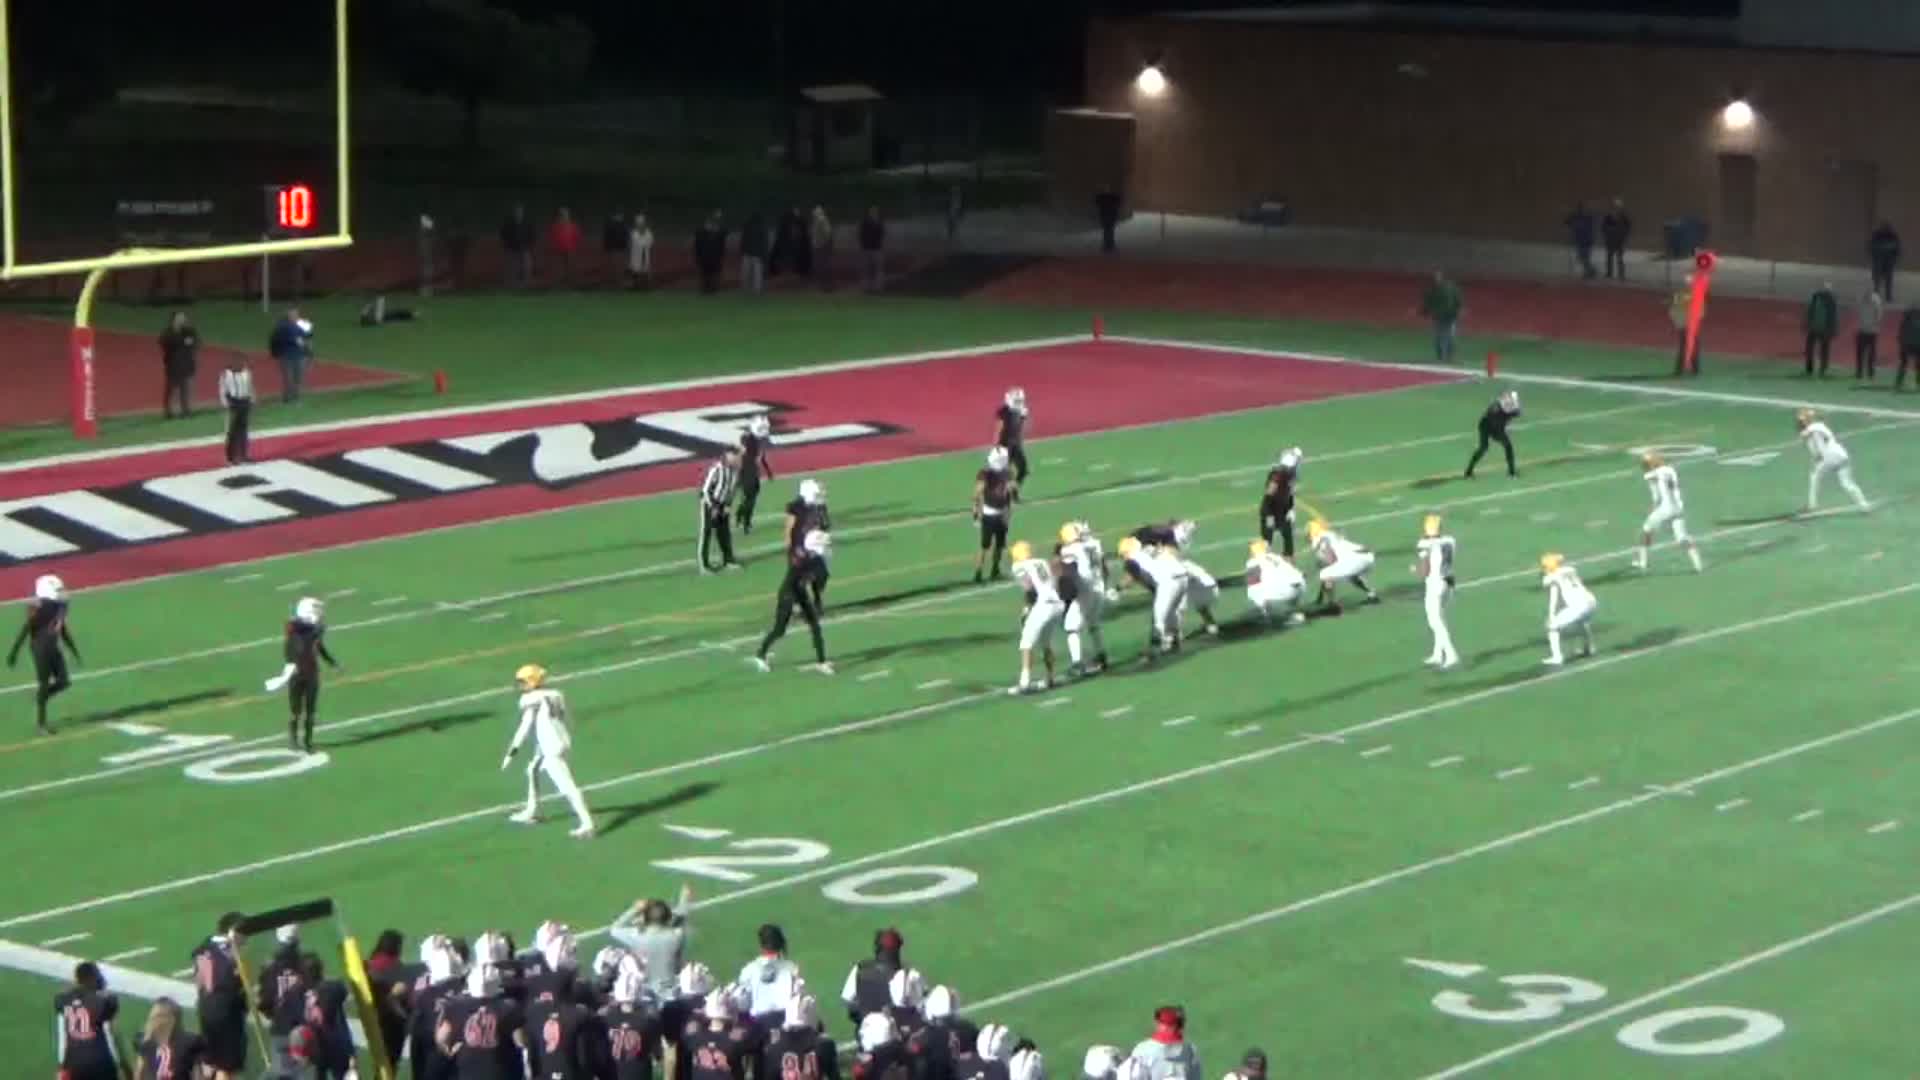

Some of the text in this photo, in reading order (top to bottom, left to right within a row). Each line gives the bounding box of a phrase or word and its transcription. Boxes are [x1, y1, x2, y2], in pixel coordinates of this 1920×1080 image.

[279, 186, 312, 228] 10
[100, 733, 331, 782] 10
[649, 837, 979, 904] 20
[1431, 974, 1786, 1055] 30
